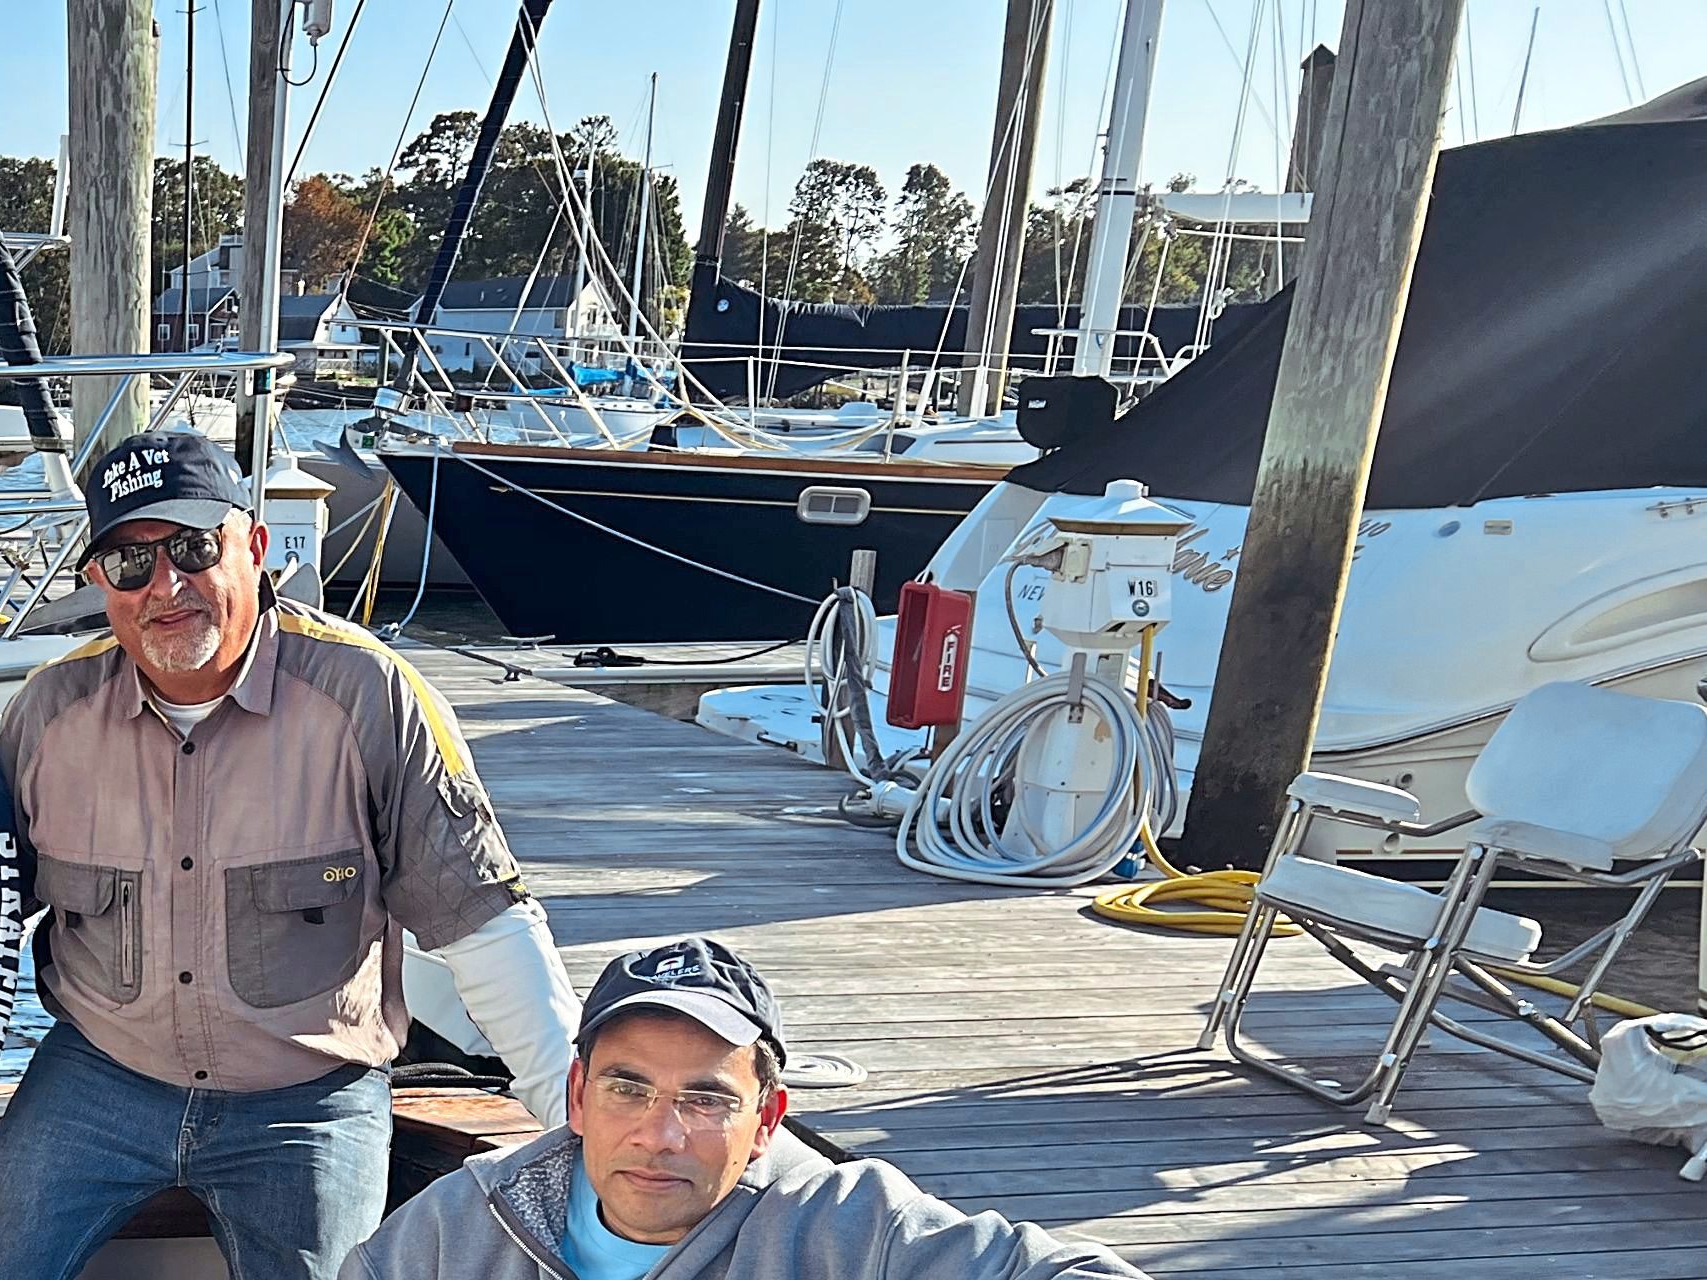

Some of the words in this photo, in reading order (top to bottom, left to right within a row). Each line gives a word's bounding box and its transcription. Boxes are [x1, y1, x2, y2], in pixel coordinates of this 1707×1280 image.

[128, 451, 141, 472] A
[141, 449, 170, 465] Vet
[110, 469, 164, 503] Fishing
[284, 536, 306, 550] E17
[1128, 579, 1153, 596] W16
[942, 641, 955, 688] FIRE
[644, 964, 701, 980] AVELERS
